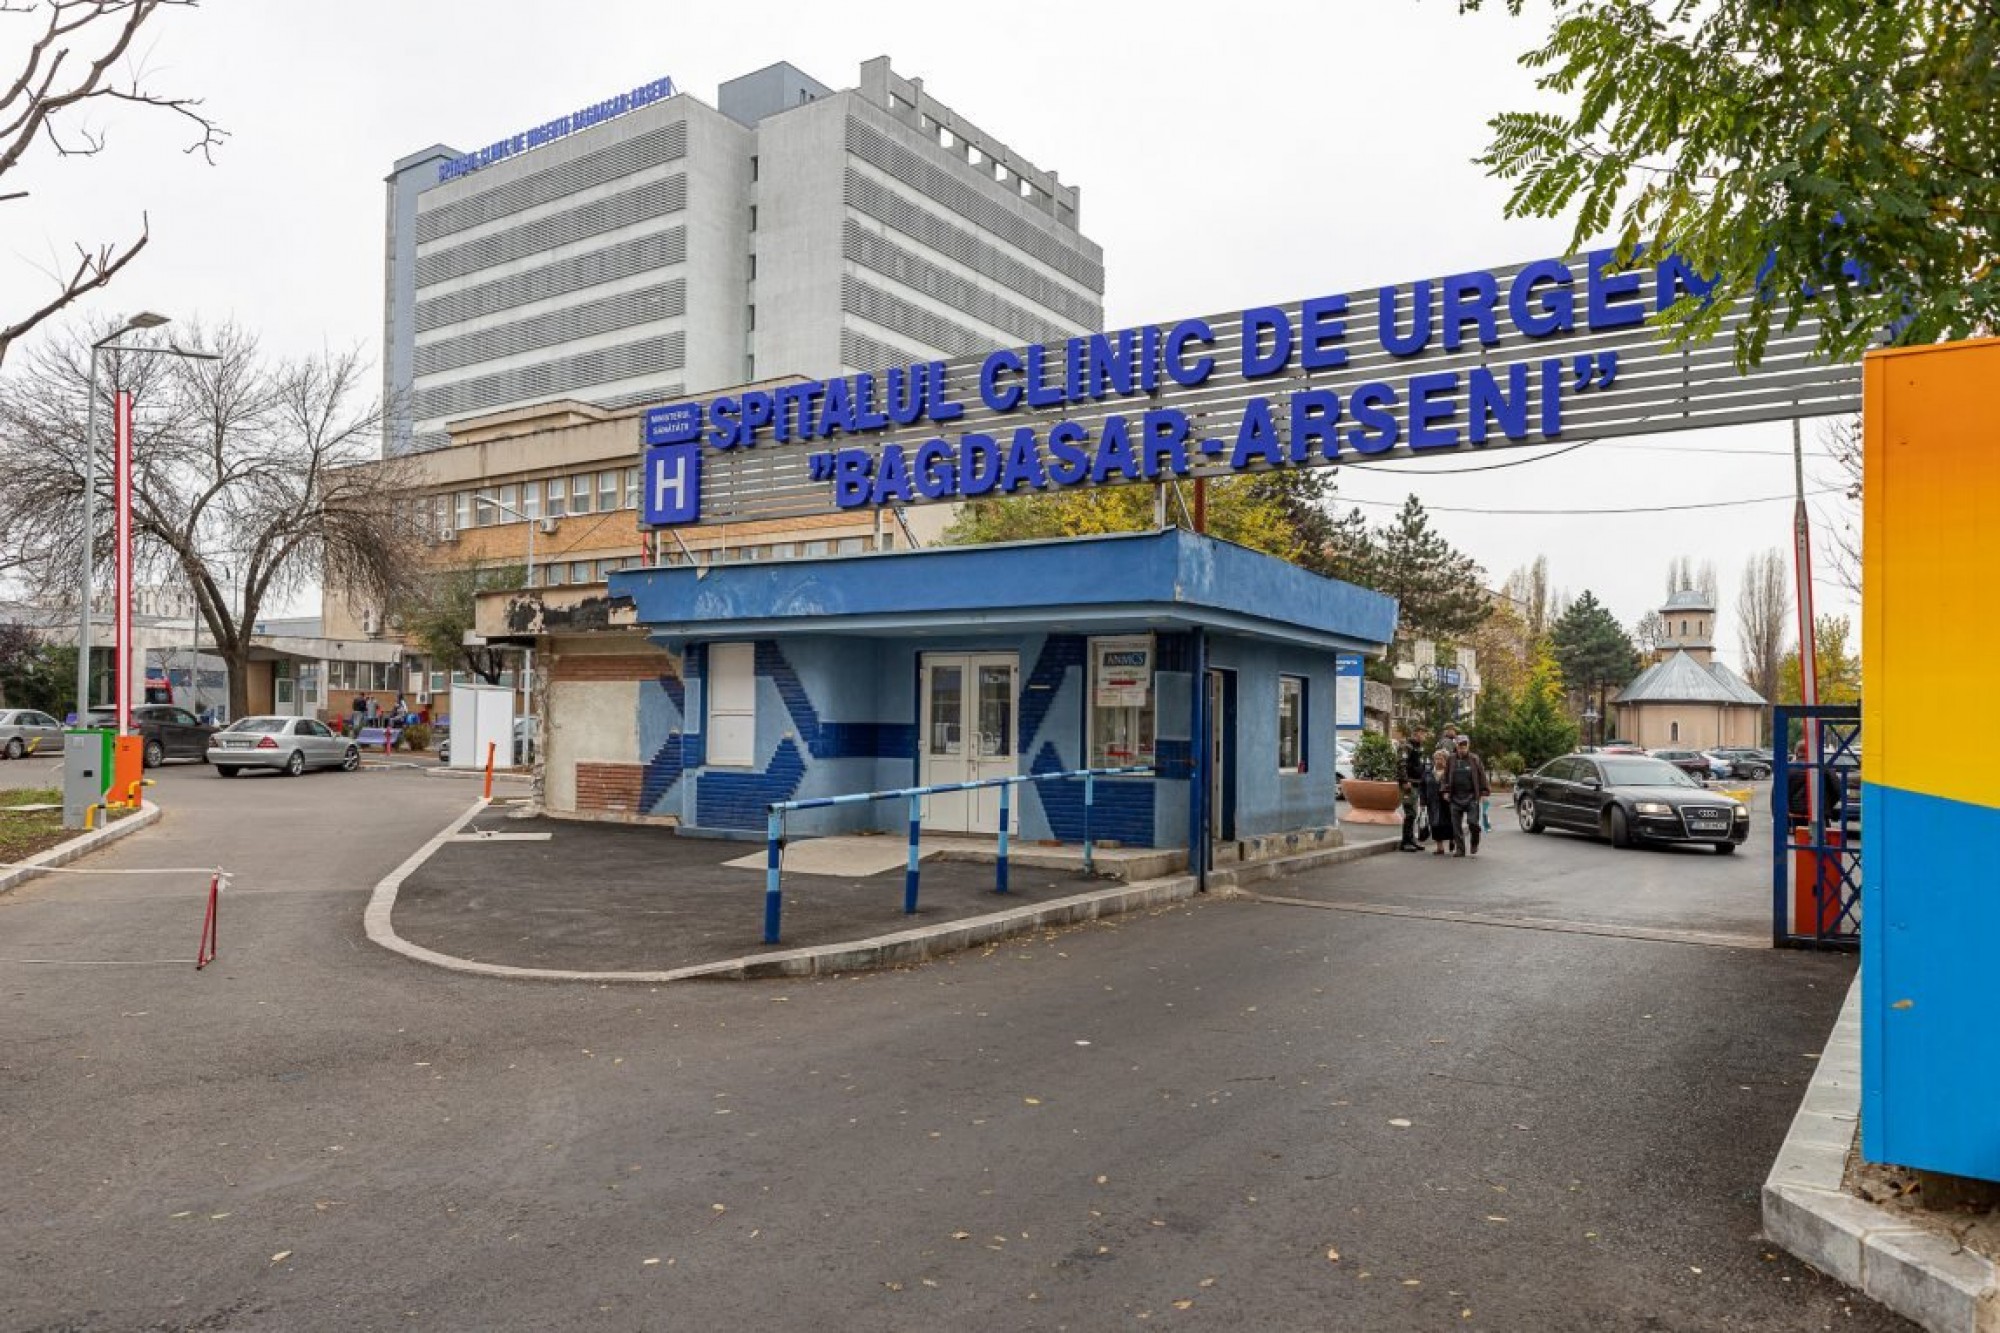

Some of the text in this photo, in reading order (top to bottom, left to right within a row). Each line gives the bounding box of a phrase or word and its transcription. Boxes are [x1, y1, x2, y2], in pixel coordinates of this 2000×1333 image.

[708, 361, 965, 450] SPITALUL
[979, 318, 1216, 412] CLINIC
[1241, 293, 1351, 379] DE
[654, 456, 685, 511] H
